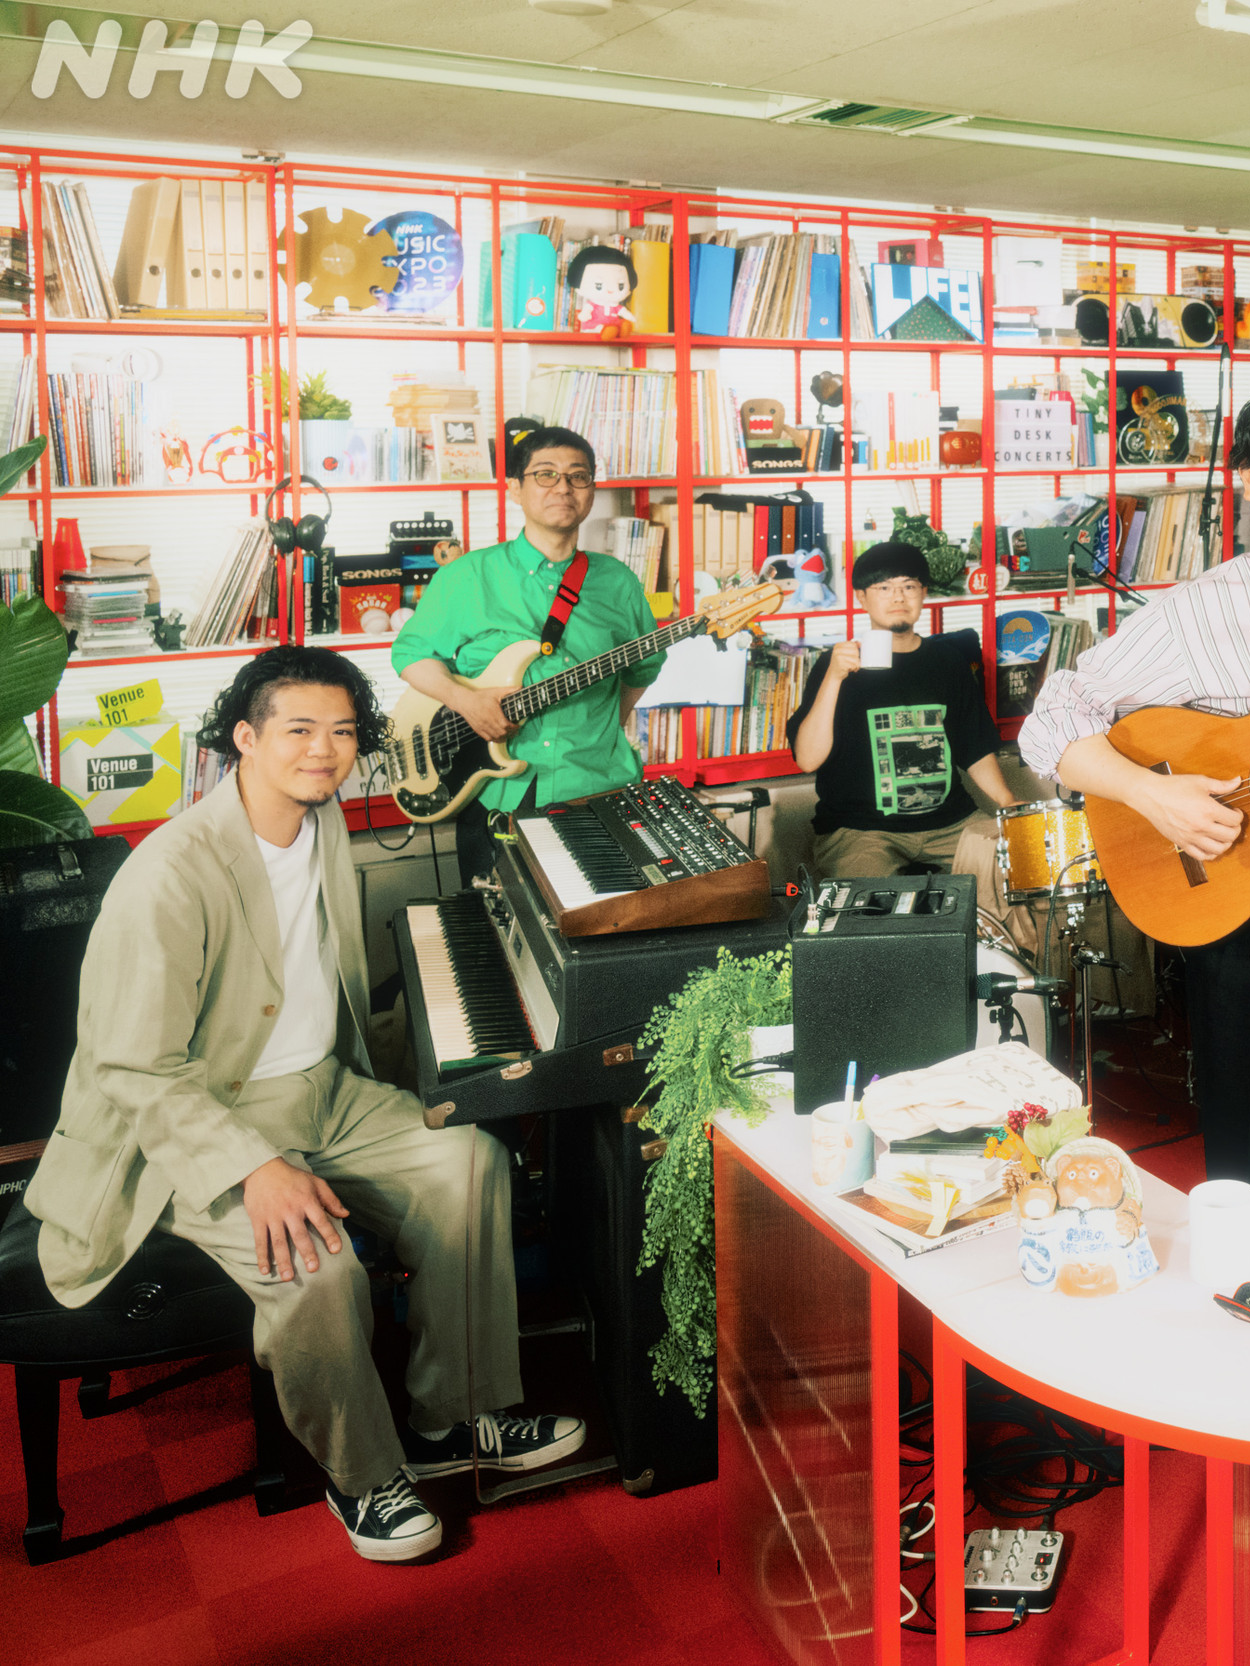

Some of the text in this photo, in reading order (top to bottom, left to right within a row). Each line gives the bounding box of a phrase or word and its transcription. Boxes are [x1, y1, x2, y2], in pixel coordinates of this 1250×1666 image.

[396, 234, 446, 255] USIC
[385, 255, 447, 276] XPO
[872, 264, 984, 343] LIFE!
[1015, 408, 1052, 418] TINY
[1013, 430, 1052, 440] DESK
[751, 460, 803, 468] SONGS
[994, 451, 1072, 462] CONCERTS
[342, 567, 403, 580] SONGS
[99, 687, 145, 710] Venue
[105, 709, 129, 727] 101
[90, 758, 138, 774] Venue
[91, 775, 116, 791] 101
